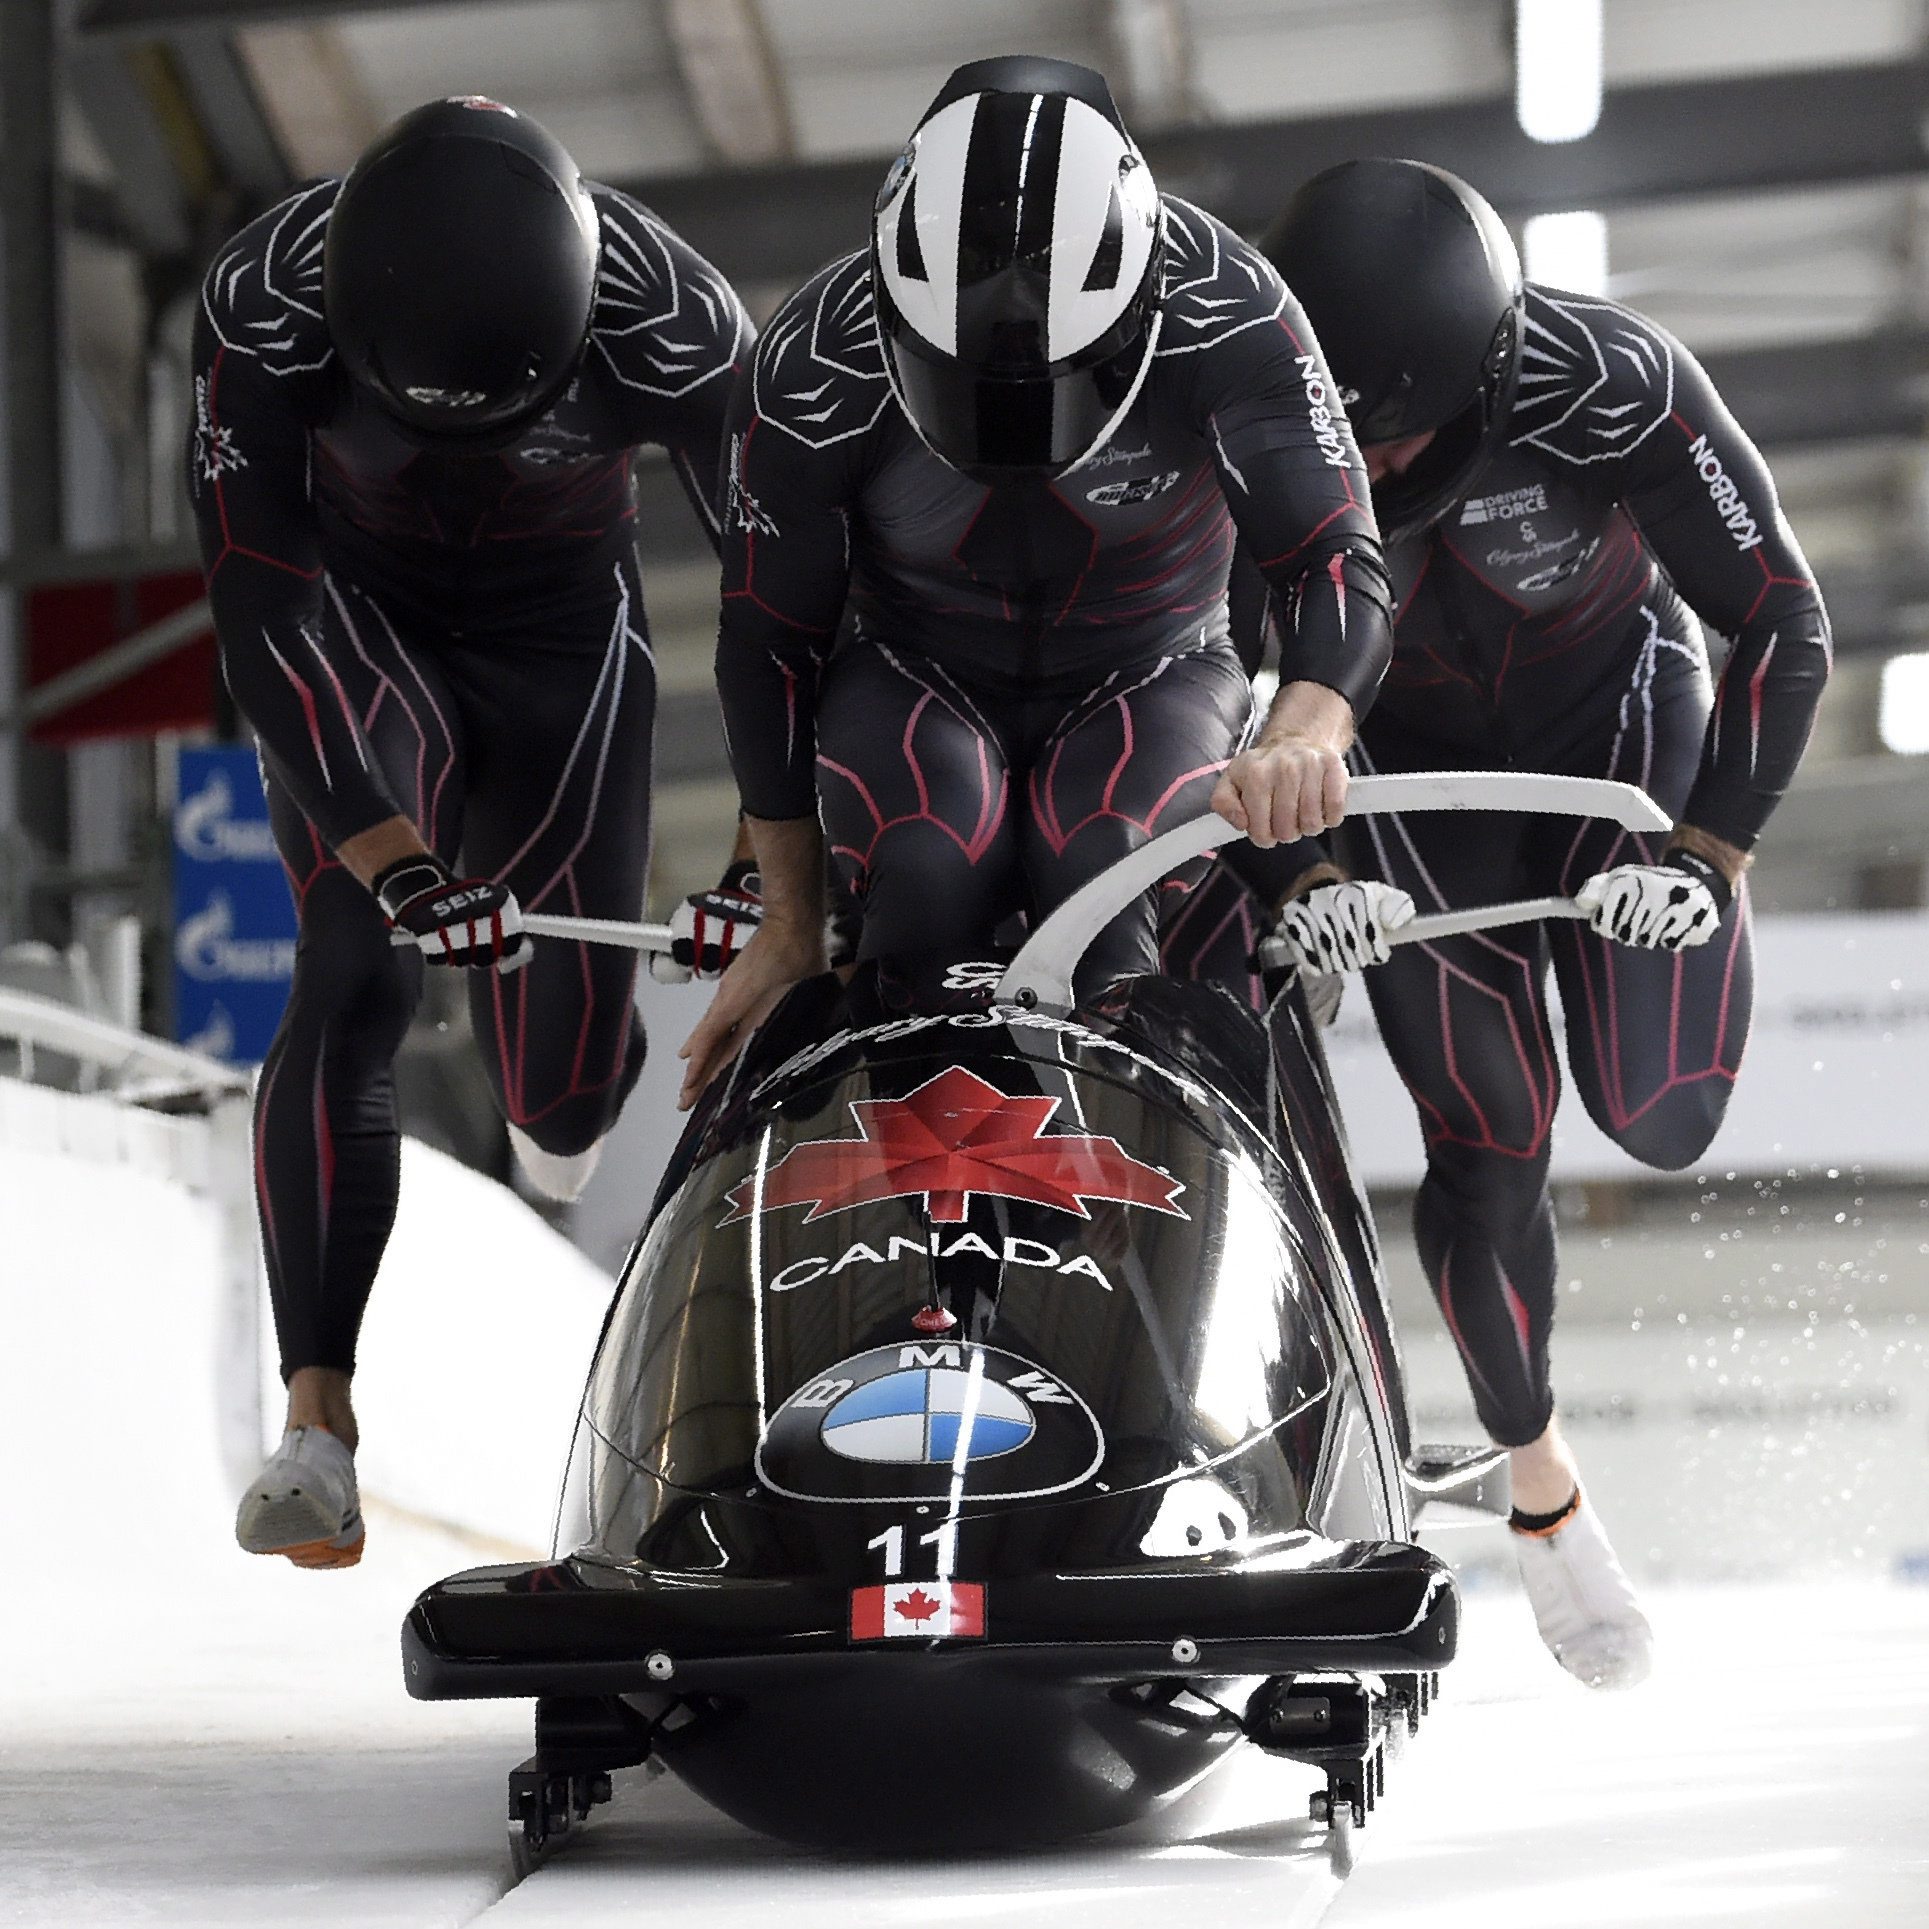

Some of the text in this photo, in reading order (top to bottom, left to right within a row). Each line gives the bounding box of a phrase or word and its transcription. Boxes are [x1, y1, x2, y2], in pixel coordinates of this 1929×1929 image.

[1294, 354, 1352, 469] KARBON
[1486, 483, 1545, 507] DRIVING
[1488, 496, 1548, 521] FORCE
[1688, 433, 1763, 551] KARBON
[432, 886, 493, 917] SEIZ
[769, 1232, 1113, 1292] CANADA
[790, 1345, 1075, 1408] BMW
[867, 1524, 957, 1576] 11
